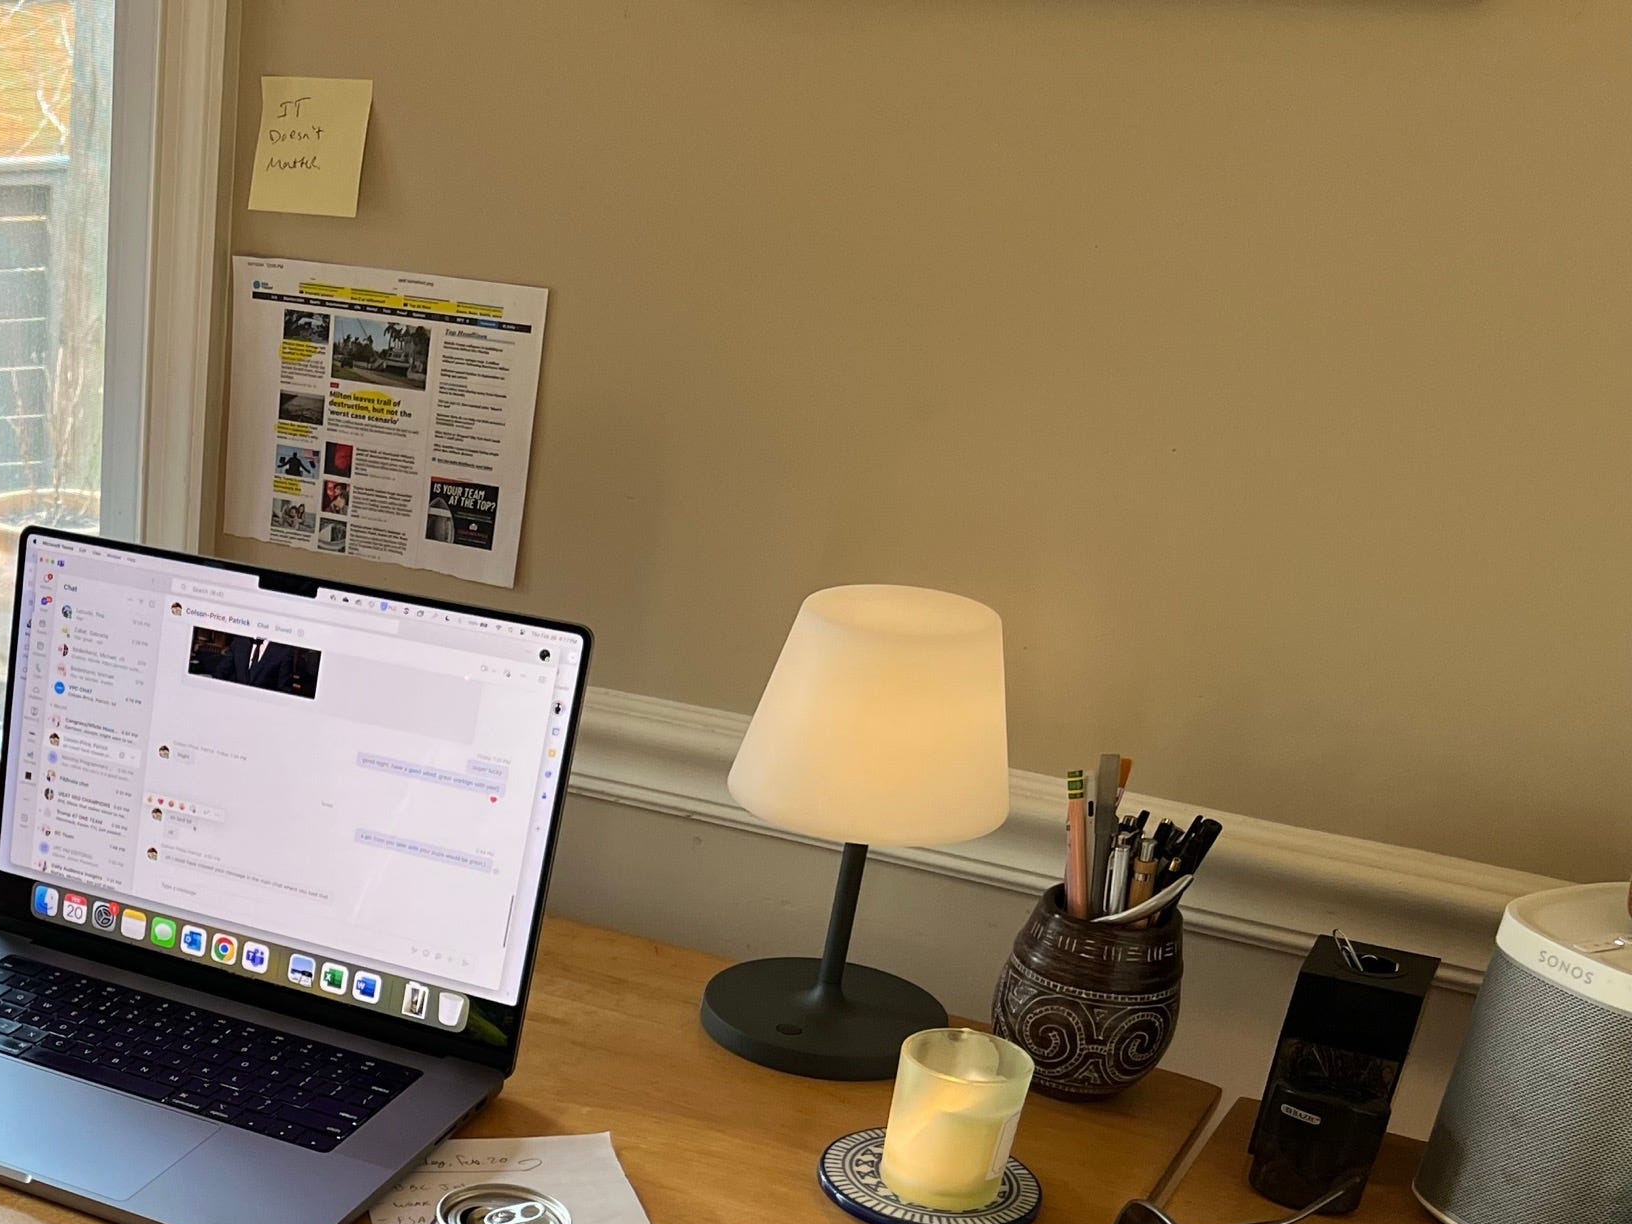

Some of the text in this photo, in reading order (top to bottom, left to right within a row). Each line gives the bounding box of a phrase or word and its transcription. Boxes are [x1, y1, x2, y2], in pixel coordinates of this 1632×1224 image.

[329, 390, 402, 408] Milton leaves trail of
[328, 399, 371, 413] destruction,
[372, 405, 385, 414] but
[400, 409, 412, 418] the
[433, 482, 485, 500] IS YOUR TEAM
[448, 495, 497, 513] AT THE TOP?
[63, 583, 77, 592] Chat
[228, 615, 250, 626] Patrick
[66, 904, 83, 920] 20
[1539, 950, 1594, 984] SONOS
